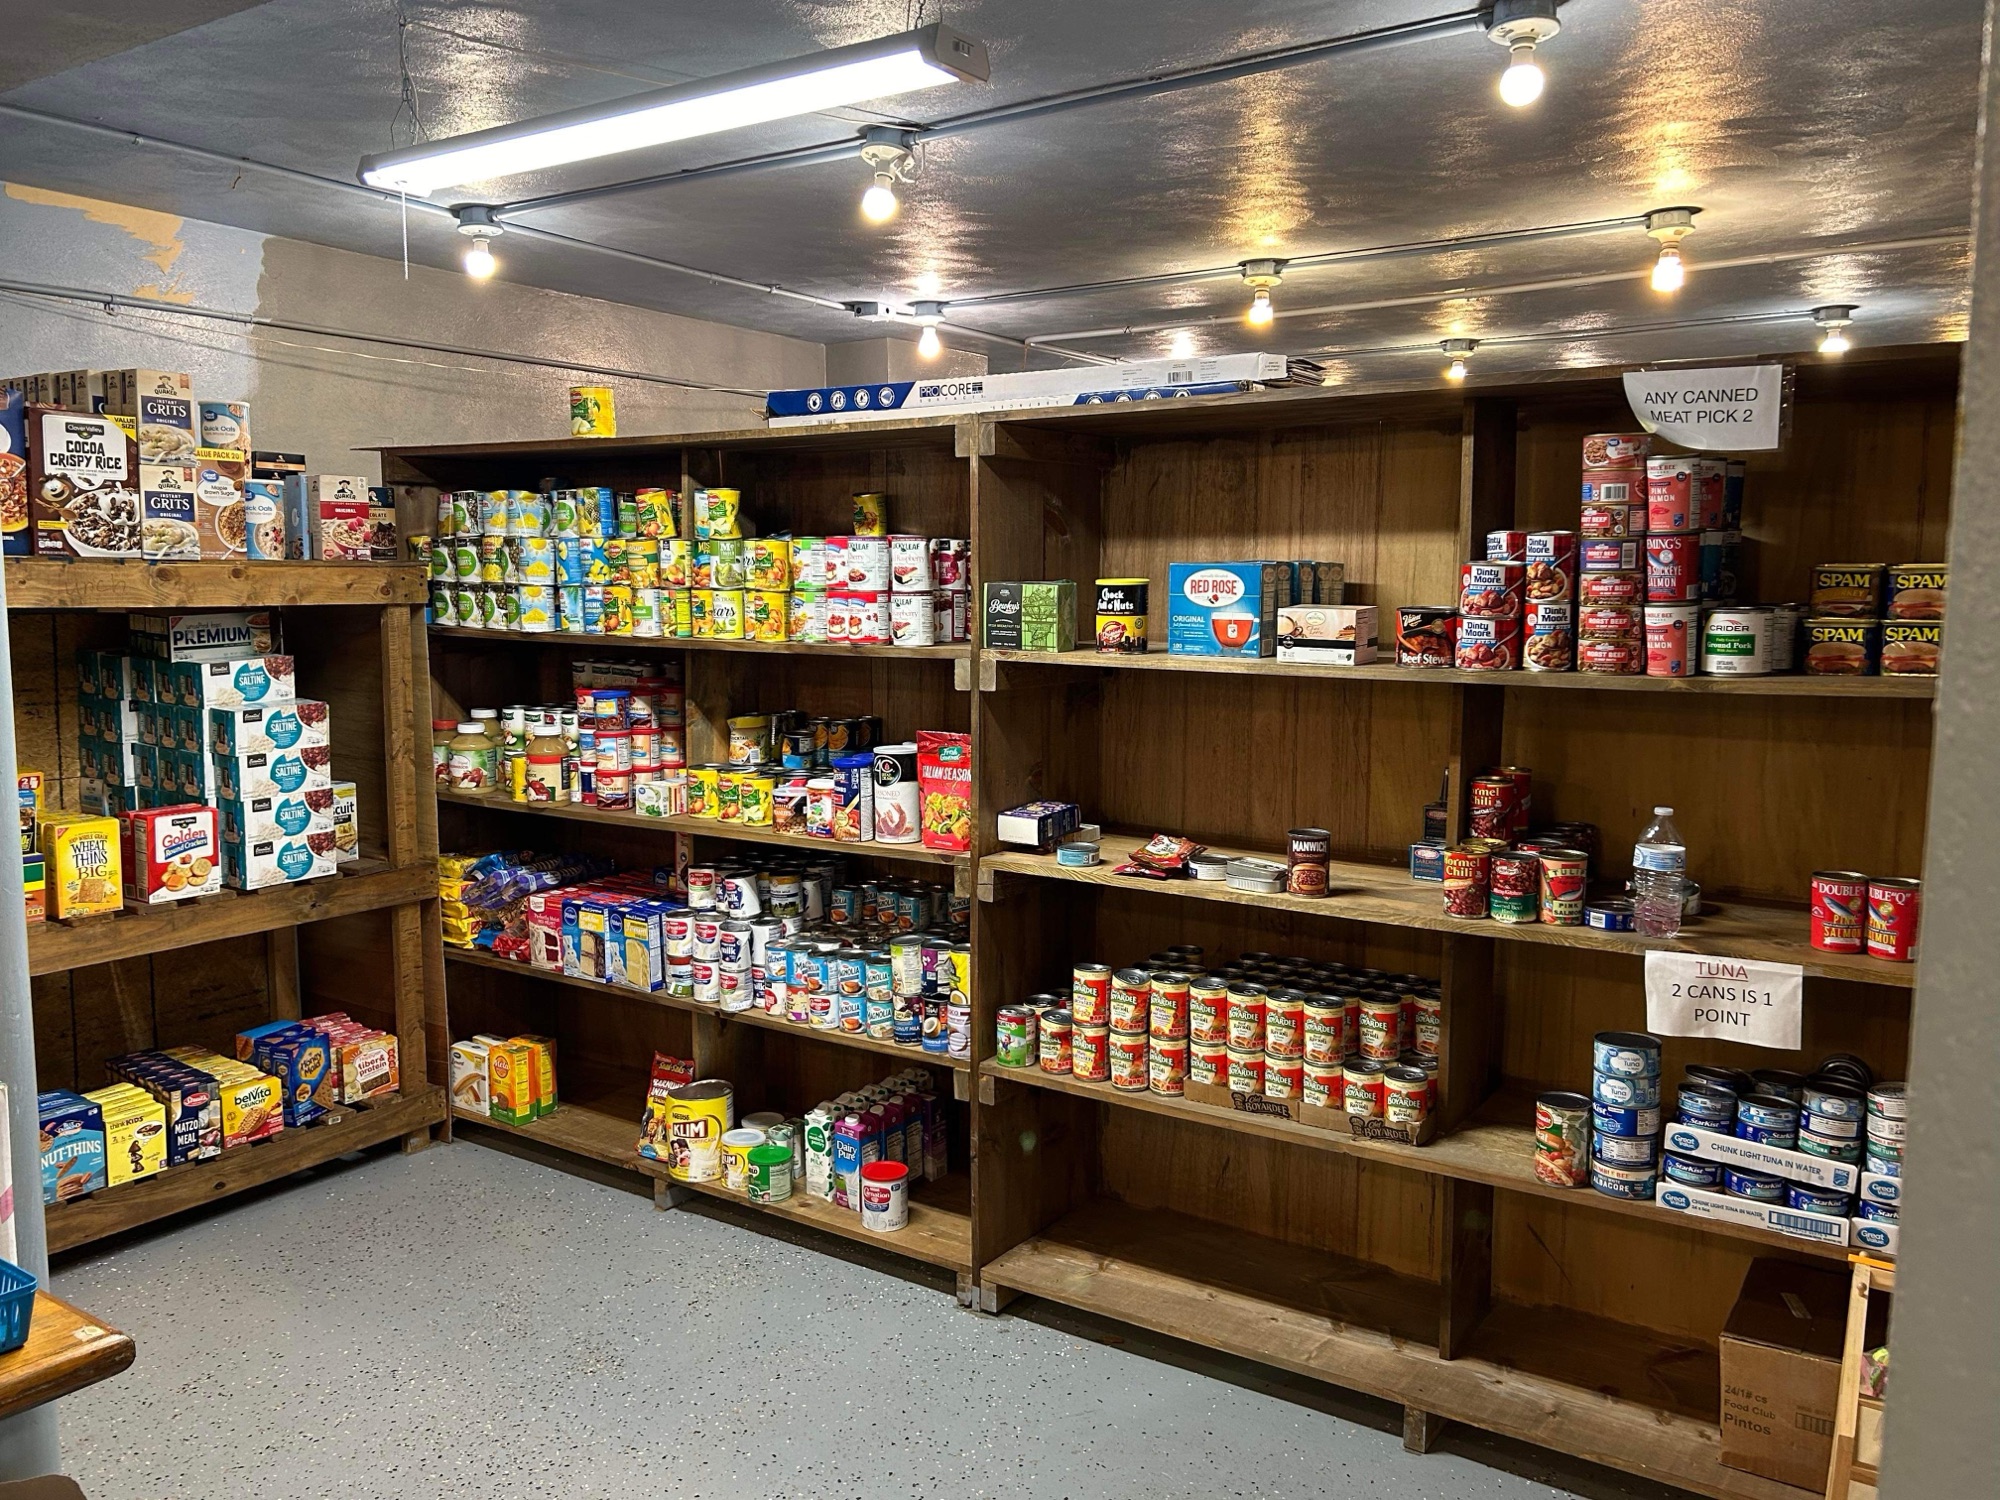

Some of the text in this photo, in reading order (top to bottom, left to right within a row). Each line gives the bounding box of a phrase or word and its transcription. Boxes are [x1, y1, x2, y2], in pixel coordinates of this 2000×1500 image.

[154, 388, 177, 396] QUAKER
[1645, 388, 1758, 404] ANY CANNED
[147, 403, 186, 417] GRITS
[1651, 409, 1752, 423] MEAT PICK 2
[66, 440, 105, 456] COCOA
[151, 498, 189, 510] GRITS
[1476, 568, 1499, 577] Dinty
[1474, 575, 1501, 583] Moore
[1819, 573, 1870, 587] SPAM
[1102, 588, 1124, 599] Chock
[1191, 580, 1237, 595] RED ROSE
[1544, 607, 1566, 615] Dinty
[1173, 615, 1205, 623] ORIGINAL
[1467, 622, 1488, 631] Dinty
[173, 627, 251, 645] PREMIUM
[1465, 629, 1491, 637] Moore
[1812, 628, 1864, 641] SPAM
[1885, 627, 1940, 641] SPAM
[1402, 652, 1445, 664] Beef Stew
[239, 675, 265, 685] SALTINE
[270, 721, 297, 732] SALTINE
[275, 765, 302, 776] SALTINE
[280, 809, 306, 820] SALTINE
[162, 829, 207, 848] Golden
[71, 840, 107, 853] WHEAT
[166, 837, 207, 855] Round Crackers
[1292, 840, 1327, 852] MANWICH
[282, 853, 308, 864] SALTINE
[1446, 866, 1472, 877] Chili
[1834, 915, 1856, 924] PINK
[1696, 961, 1748, 979] TUNA
[1672, 984, 1772, 1006] 2 CANS IS 1
[1694, 1009, 1750, 1026] POINT
[299, 1052, 322, 1072] Honey
[304, 1061, 320, 1076] Maid
[359, 1061, 387, 1076] protein
[235, 1086, 272, 1106] belVita
[1249, 1095, 1261, 1103] Chef
[1345, 1089, 1376, 1101] BOYARDEE
[240, 1098, 266, 1109] CRUNCHY
[1350, 1102, 1369, 1110] Ravioli
[1387, 1096, 1421, 1108] BOYARDEE
[1245, 1102, 1290, 1117] BOYARDEE
[1393, 1110, 1413, 1118] Ravioli
[175, 1120, 198, 1134] MATZO
[1370, 1120, 1383, 1129] Chef
[1691, 1117, 1719, 1128] StarKist
[674, 1121, 705, 1137] KLIM
[1364, 1126, 1410, 1142] BOYARDEE
[178, 1133, 196, 1146] MEAL
[1673, 1133, 1694, 1144] Great
[837, 1141, 857, 1152] Dairy
[41, 1140, 101, 1166] NUT-THINS
[838, 1150, 855, 1161] Pure
[1711, 1143, 1821, 1175] CHUNK LIGHT TUNA IN WATER
[810, 1158, 823, 1166] MILK
[1675, 1162, 1703, 1174] StarKist
[1872, 1181, 1895, 1193] Great
[1878, 1189, 1895, 1197] Value
[1665, 1192, 1685, 1203] Great
[1813, 1198, 1842, 1206] StarKist
[1692, 1199, 1709, 1207] CHUNK
[1725, 1205, 1738, 1213] TUNA
[1861, 1230, 1884, 1240] Great
[1725, 1384, 1768, 1404] 24/1# cs
[1724, 1398, 1776, 1420] Food Club
[1724, 1412, 1772, 1435] Pintos
